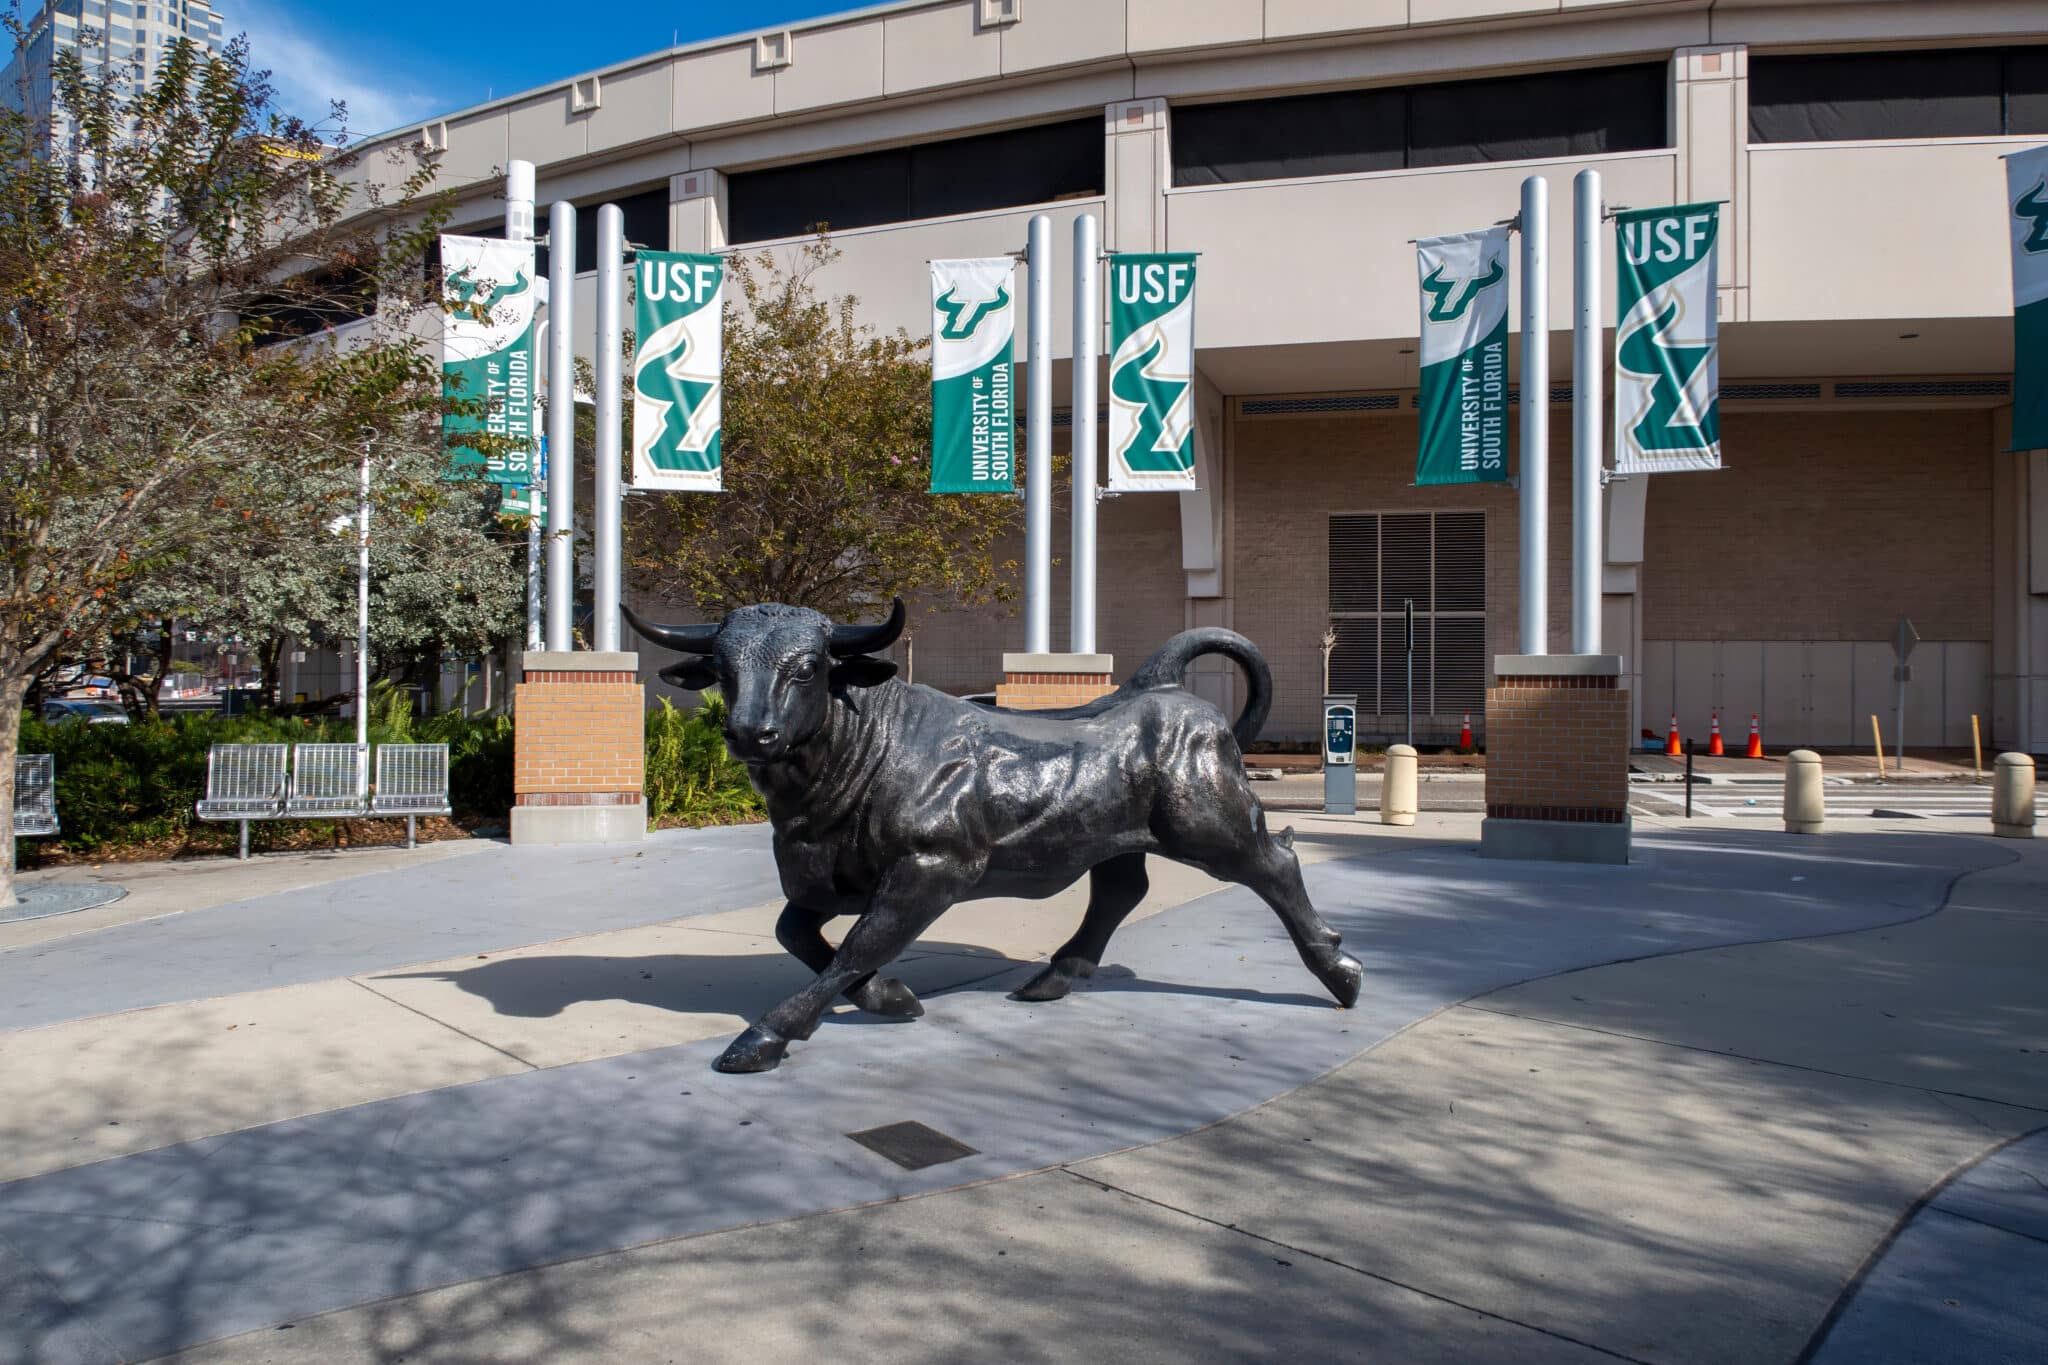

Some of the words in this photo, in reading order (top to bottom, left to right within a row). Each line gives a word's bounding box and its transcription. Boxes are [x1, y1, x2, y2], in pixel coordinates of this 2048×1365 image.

[1626, 214, 1709, 265] USF
[644, 260, 716, 304] USF
[1119, 263, 1188, 304] USF
[487, 361, 500, 374] OF
[509, 350, 528, 416] FLORIDA
[972, 376, 983, 389] OF
[1462, 358, 1474, 372] OF
[1482, 341, 1502, 412] FLORIDA
[992, 362, 1009, 427] FLORIDA
[972, 393, 990, 481] UNIVERSITY
[1461, 376, 1480, 471] UNIVERSITY
[1482, 417, 1501, 470] SOUTH
[992, 431, 1009, 481] SOUTH
